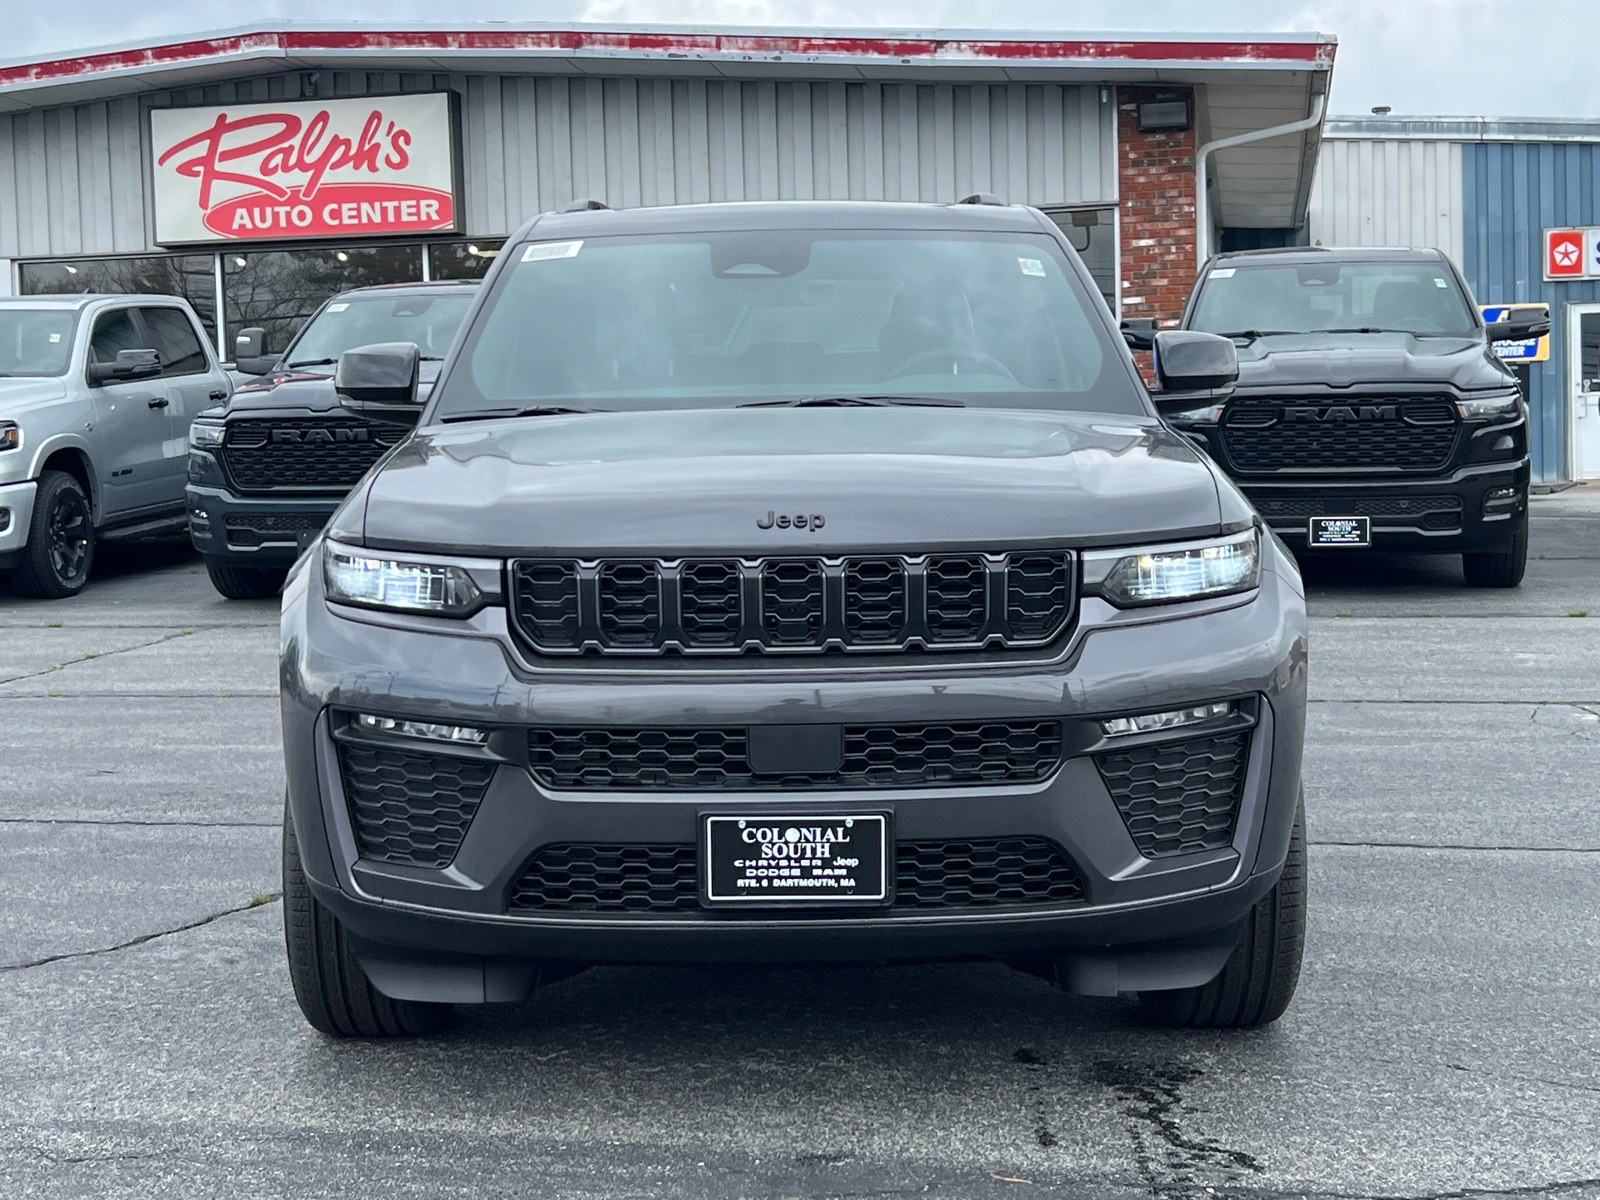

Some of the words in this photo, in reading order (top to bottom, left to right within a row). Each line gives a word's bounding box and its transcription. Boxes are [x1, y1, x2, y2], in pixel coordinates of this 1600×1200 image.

[158, 110, 412, 211] Ralph's
[232, 204, 313, 230] AUTO
[323, 199, 441, 224] CENTER
[1285, 406, 1396, 421] RAM
[272, 428, 368, 442] RAM
[757, 511, 826, 532] Jeep
[742, 827, 850, 843] COLONIAL
[761, 843, 831, 858] SOUTH
[733, 859, 822, 867] CHRYSLER
[832, 857, 859, 867] Jeep
[746, 868, 801, 876] DODGE
[812, 868, 848, 876] RAM
[737, 879, 760, 887] RTE.
[773, 878, 839, 888] DARTMOUTH,
[840, 878, 856, 887] MA
